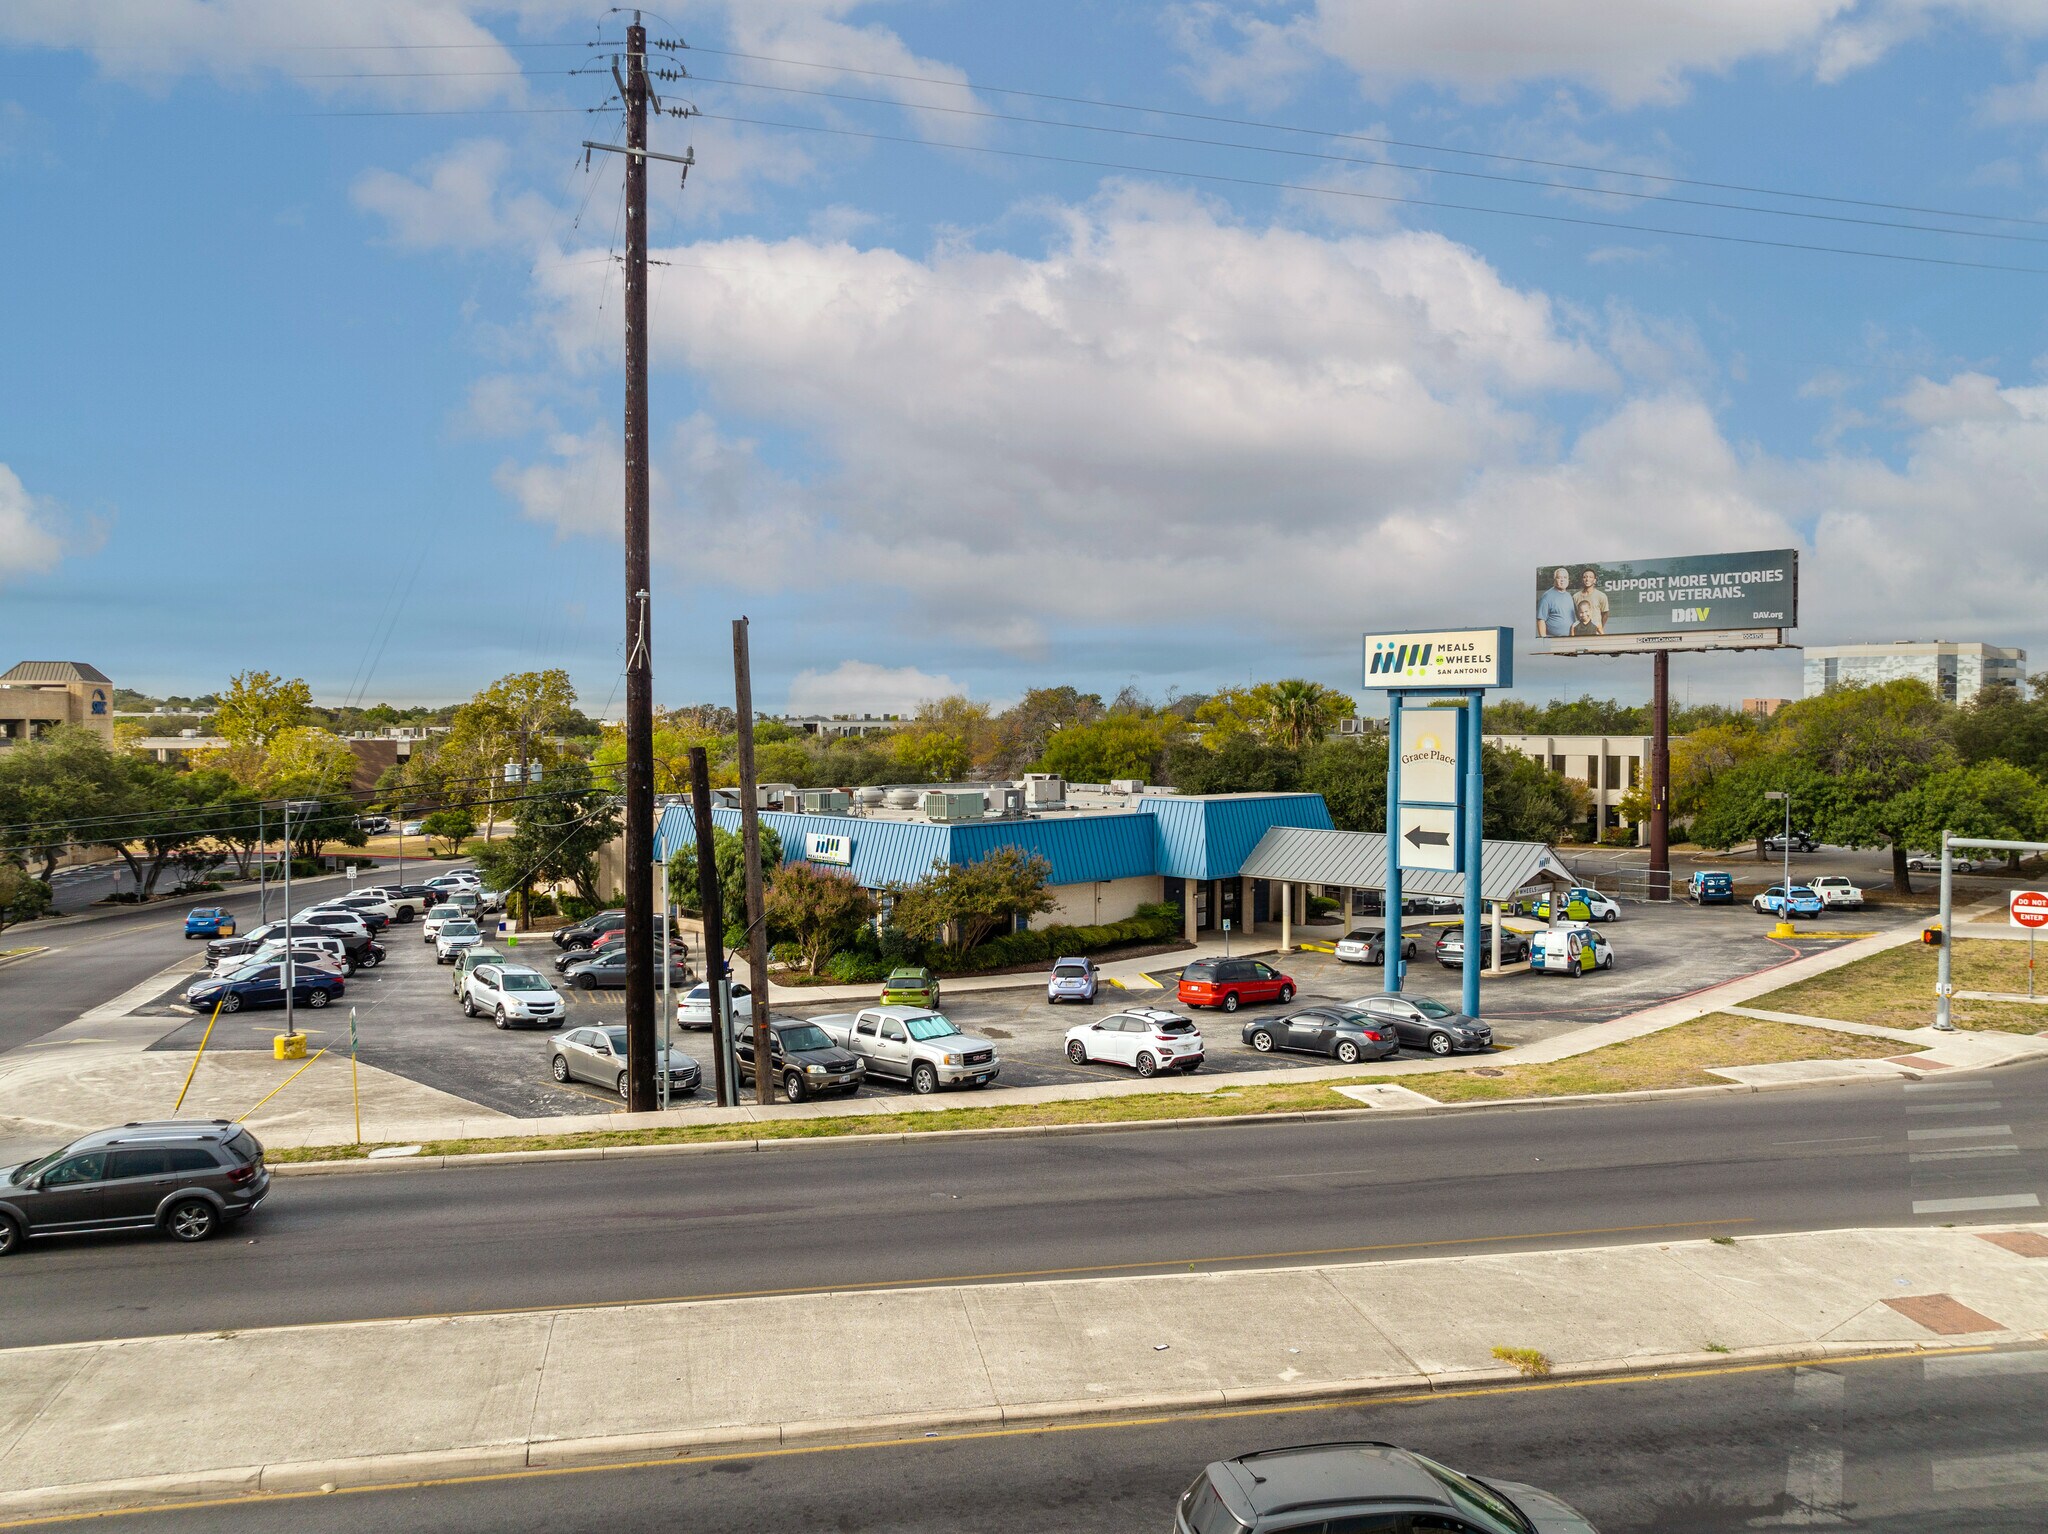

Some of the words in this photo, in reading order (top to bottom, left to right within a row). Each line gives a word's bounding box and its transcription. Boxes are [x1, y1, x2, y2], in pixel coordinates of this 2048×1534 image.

[1605, 577, 1665, 592] SUPPORT
[1668, 574, 1707, 588] MORE
[1710, 569, 1783, 585] VICTORIES
[1638, 590, 1665, 603] FOR
[1669, 586, 1745, 601] VETERANS.
[1671, 607, 1711, 623] DAV
[1753, 611, 1783, 620] DAV.org
[1437, 643, 1474, 652] MEALS
[1446, 655, 1491, 663] WHEELS
[1401, 752, 1429, 764] Grace
[1430, 750, 1455, 765] Place
[2020, 913, 2044, 921] ENTER
